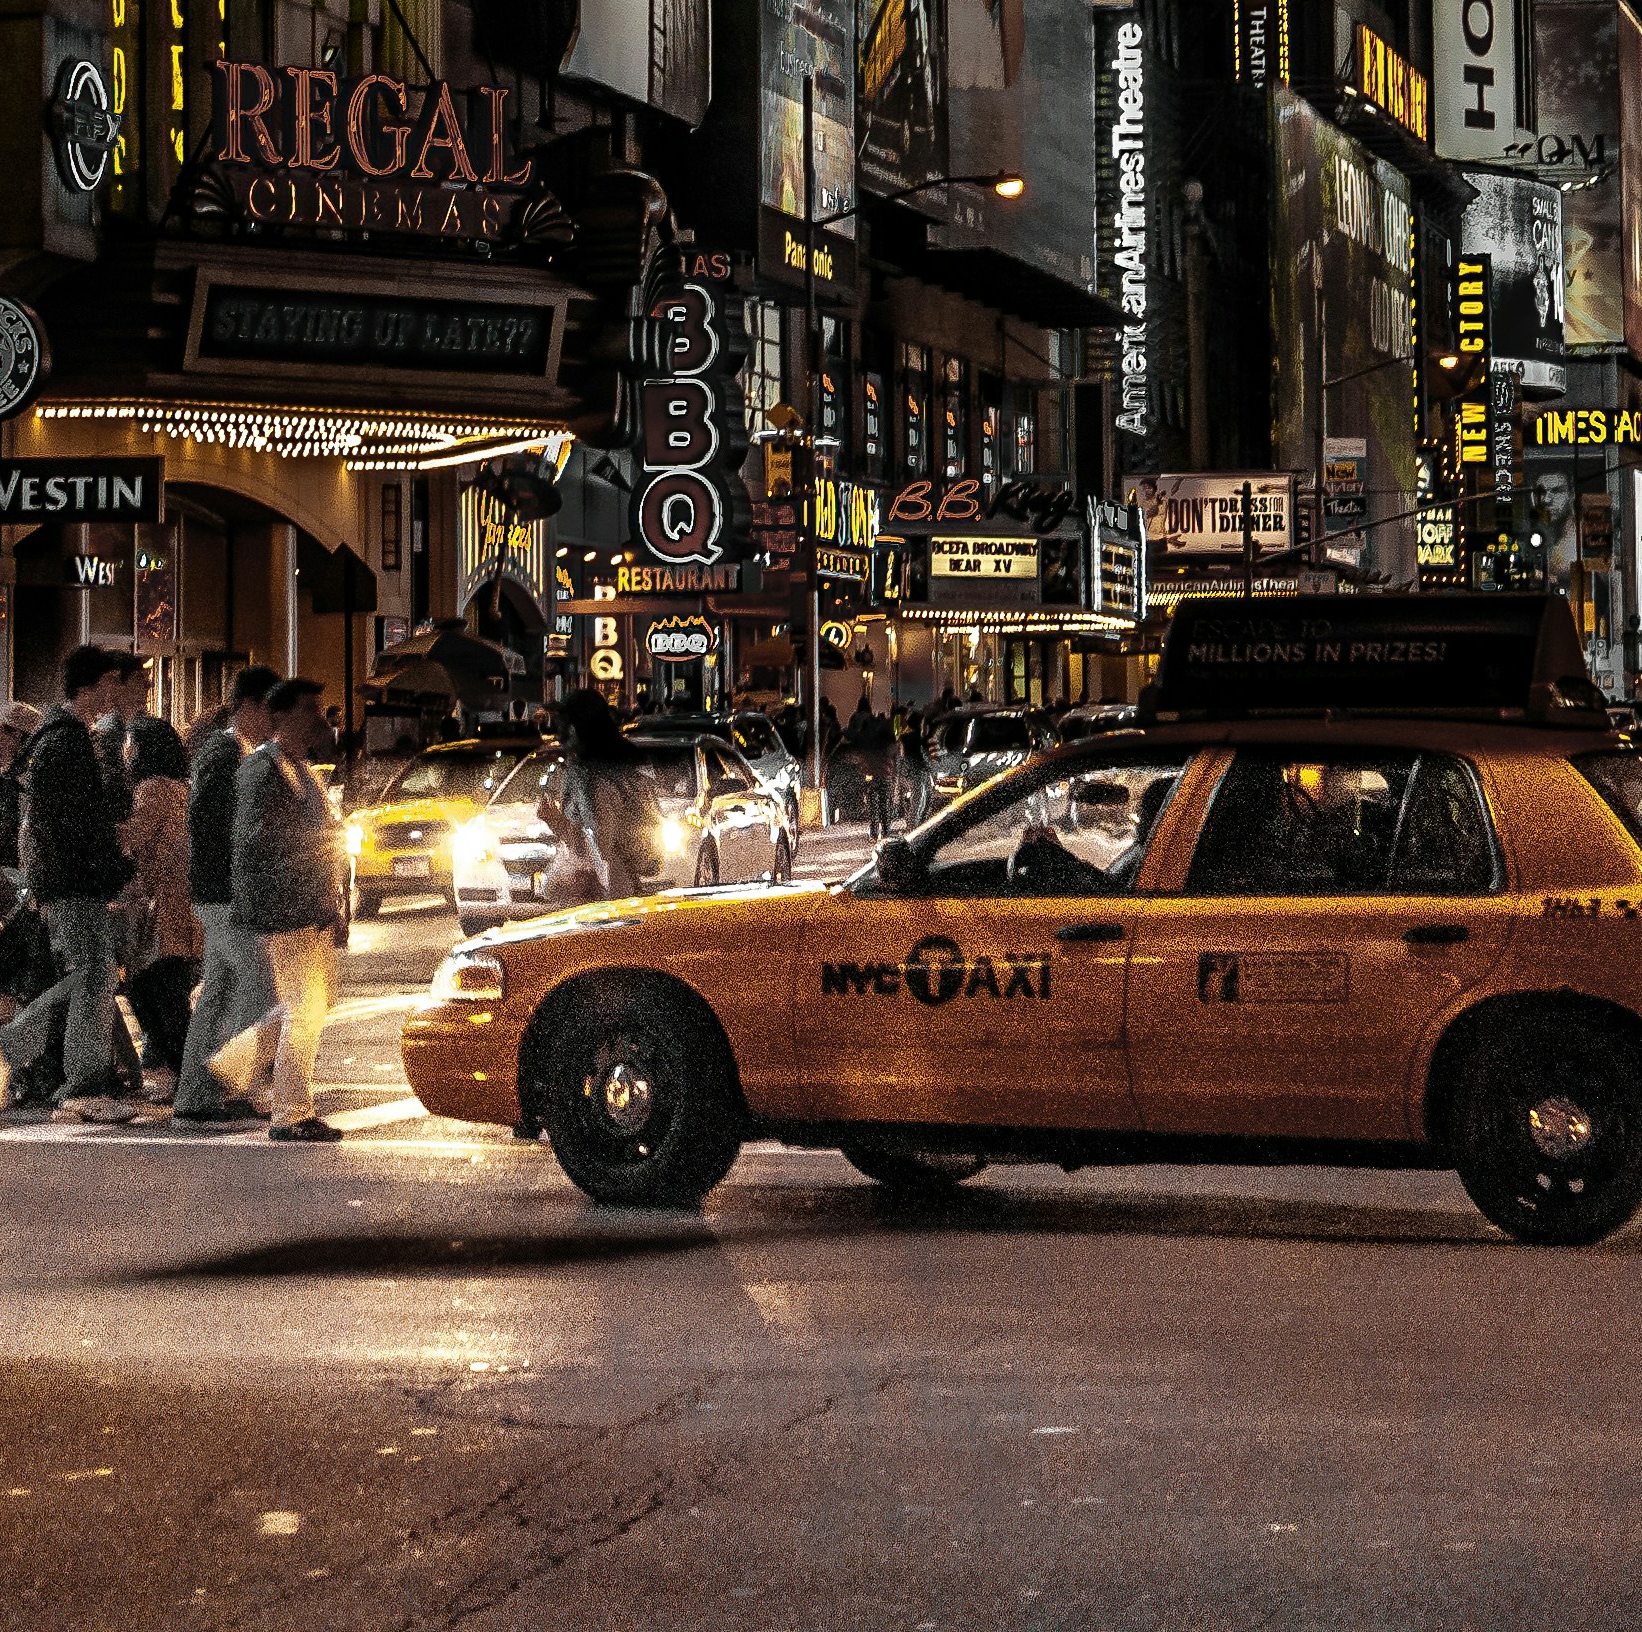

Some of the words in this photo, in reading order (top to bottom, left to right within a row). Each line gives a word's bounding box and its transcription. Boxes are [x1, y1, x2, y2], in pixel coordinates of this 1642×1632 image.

[216, 59, 533, 187] REGAL
[248, 177, 502, 235] CINEMAS
[784, 231, 834, 281] Panaonic
[213, 300, 363, 345] STAYING
[1459, 262, 1486, 368] CTORY
[639, 282, 724, 566] BBQ
[1461, 402, 1487, 463] NEW
[480, 489, 533, 563] Yanees
[803, 477, 836, 541] OLD
[889, 479, 982, 522] B.B.
[1167, 496, 1220, 535] DON'T
[1219, 496, 1268, 514] DRSS
[1219, 513, 1287, 533] DINER
[617, 565, 739, 592] RESTAURANT
[1188, 642, 1307, 665] MILLIONS
[1314, 642, 1341, 664] IN
[1350, 641, 1448, 664] PRIZES!
[819, 962, 900, 996] NYC
[906, 935, 1052, 1006] TAXI
